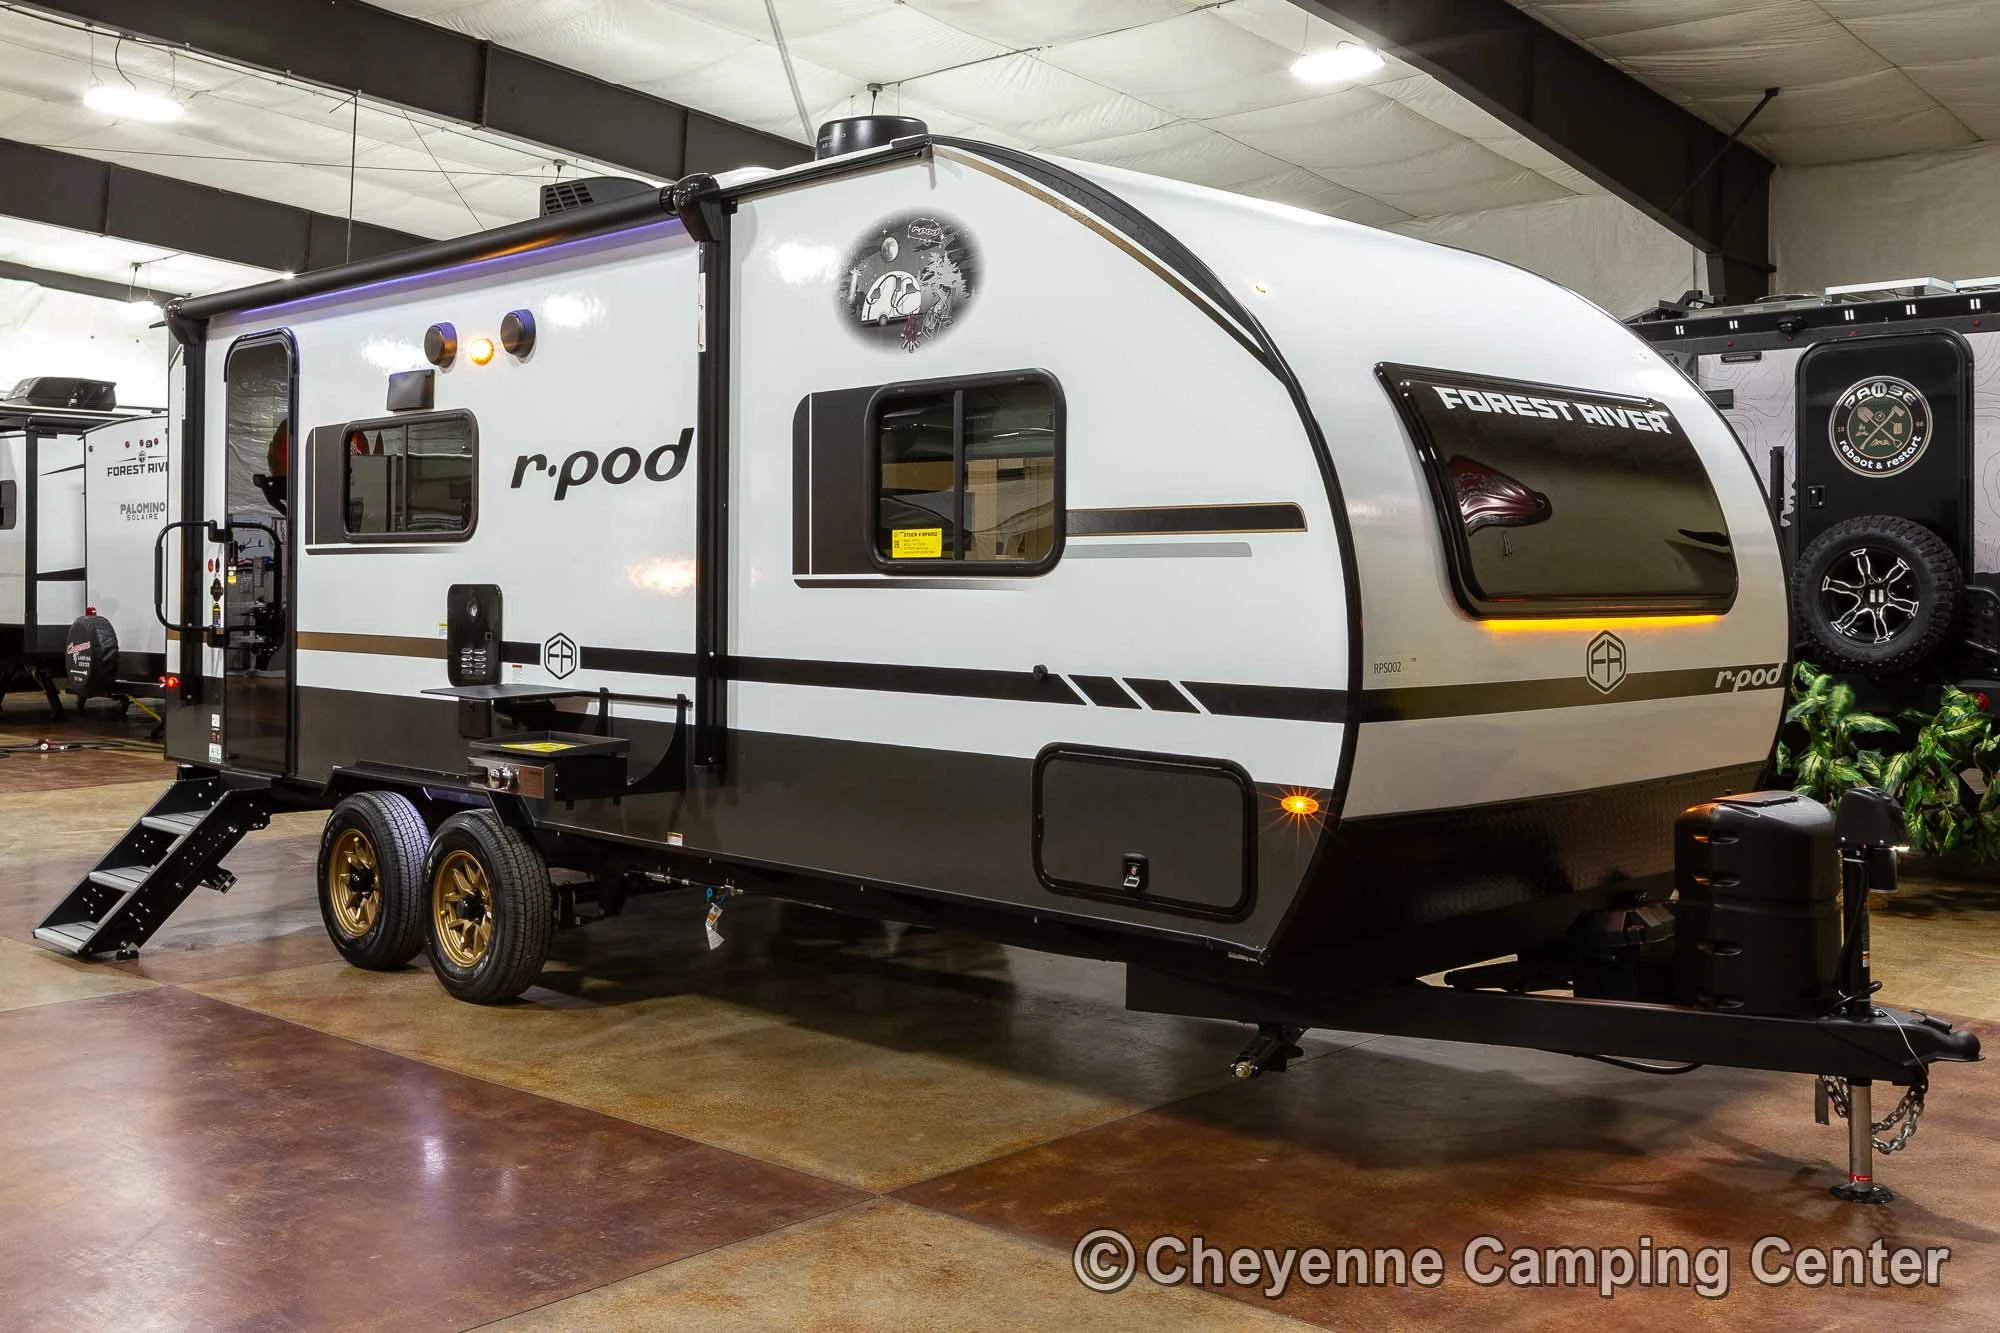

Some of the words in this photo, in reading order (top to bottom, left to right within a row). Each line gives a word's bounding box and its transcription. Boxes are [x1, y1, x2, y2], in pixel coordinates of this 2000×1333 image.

[1431, 386, 1573, 421] FOREST
[1572, 402, 1673, 434] RIVER
[1839, 440, 1874, 469] reboot
[1876, 462, 1883, 470] &
[1887, 435, 1922, 468] restart
[107, 464, 145, 477] FOREST
[120, 502, 166, 514] PALOMINO
[127, 513, 158, 521] SOLAIRE
[1373, 661, 1402, 674] RPS002
